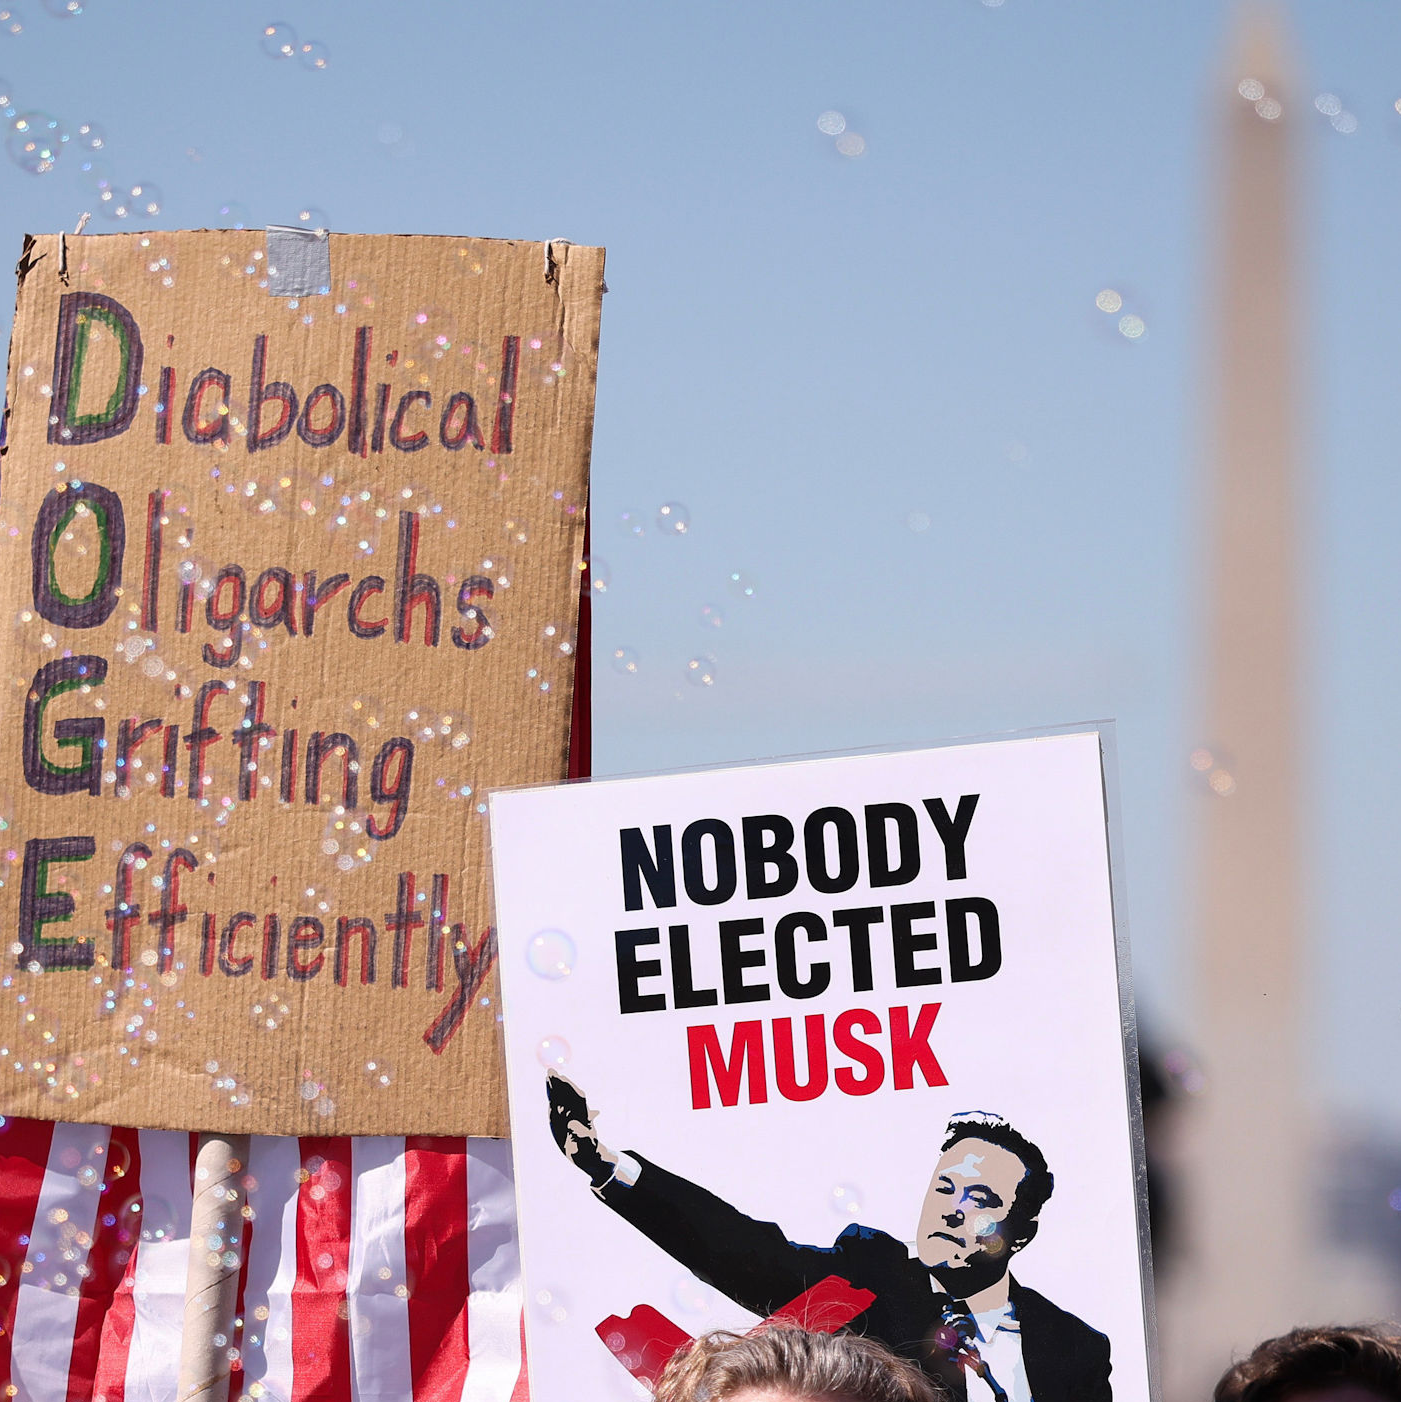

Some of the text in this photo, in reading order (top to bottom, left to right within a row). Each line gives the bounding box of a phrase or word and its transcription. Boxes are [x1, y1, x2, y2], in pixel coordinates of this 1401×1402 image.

[48, 290, 521, 456] Diabolical
[31, 482, 496, 668] Oligarchs
[22, 655, 415, 840] Grifting
[620, 794, 981, 912] NOBODY
[17, 835, 499, 1056] Efficiently
[615, 896, 1002, 1015] ELECTED
[687, 1002, 950, 1110] MUSK
